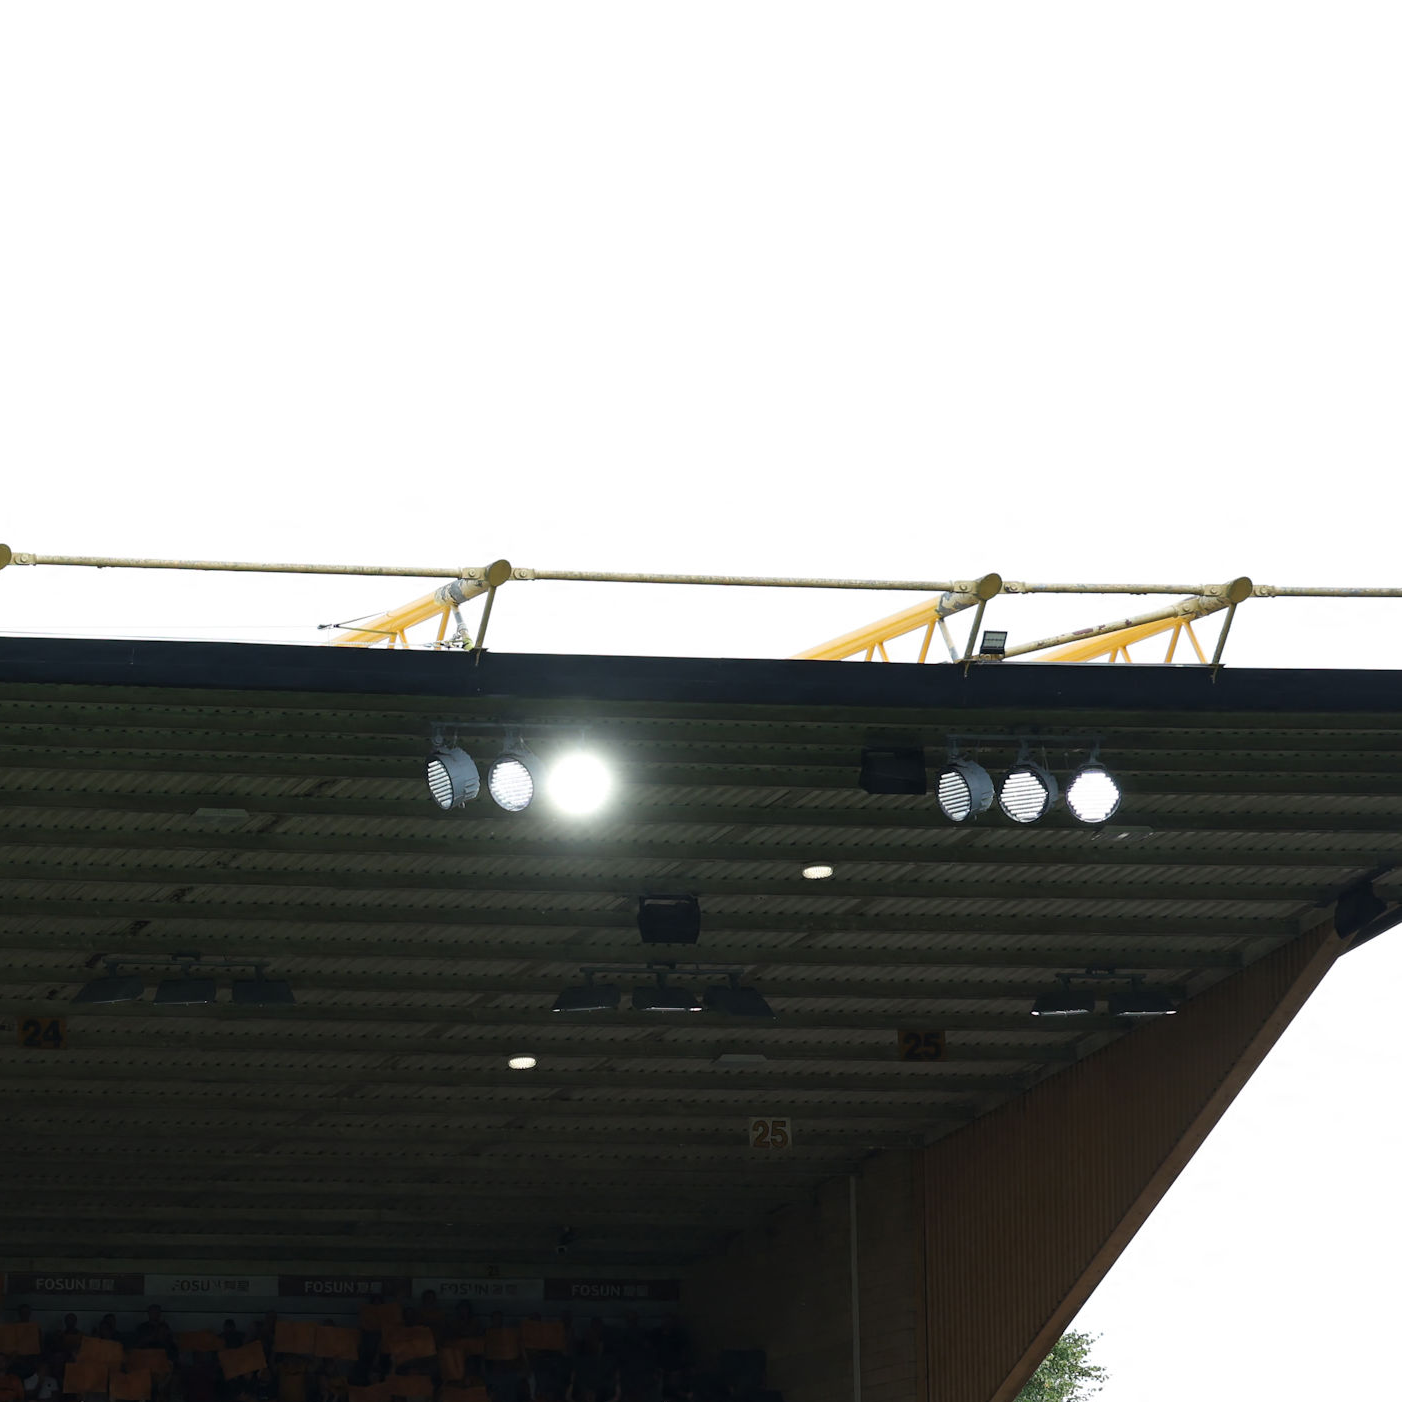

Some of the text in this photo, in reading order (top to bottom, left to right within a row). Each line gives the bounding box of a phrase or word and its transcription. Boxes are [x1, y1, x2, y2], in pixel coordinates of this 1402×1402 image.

[23, 1021, 61, 1048] 24
[903, 1032, 943, 1060] 25
[752, 1119, 789, 1147] 25
[35, 1278, 85, 1290] FOSUN
[304, 1281, 354, 1293] FOSUN
[571, 1285, 620, 1297] FOSUN
